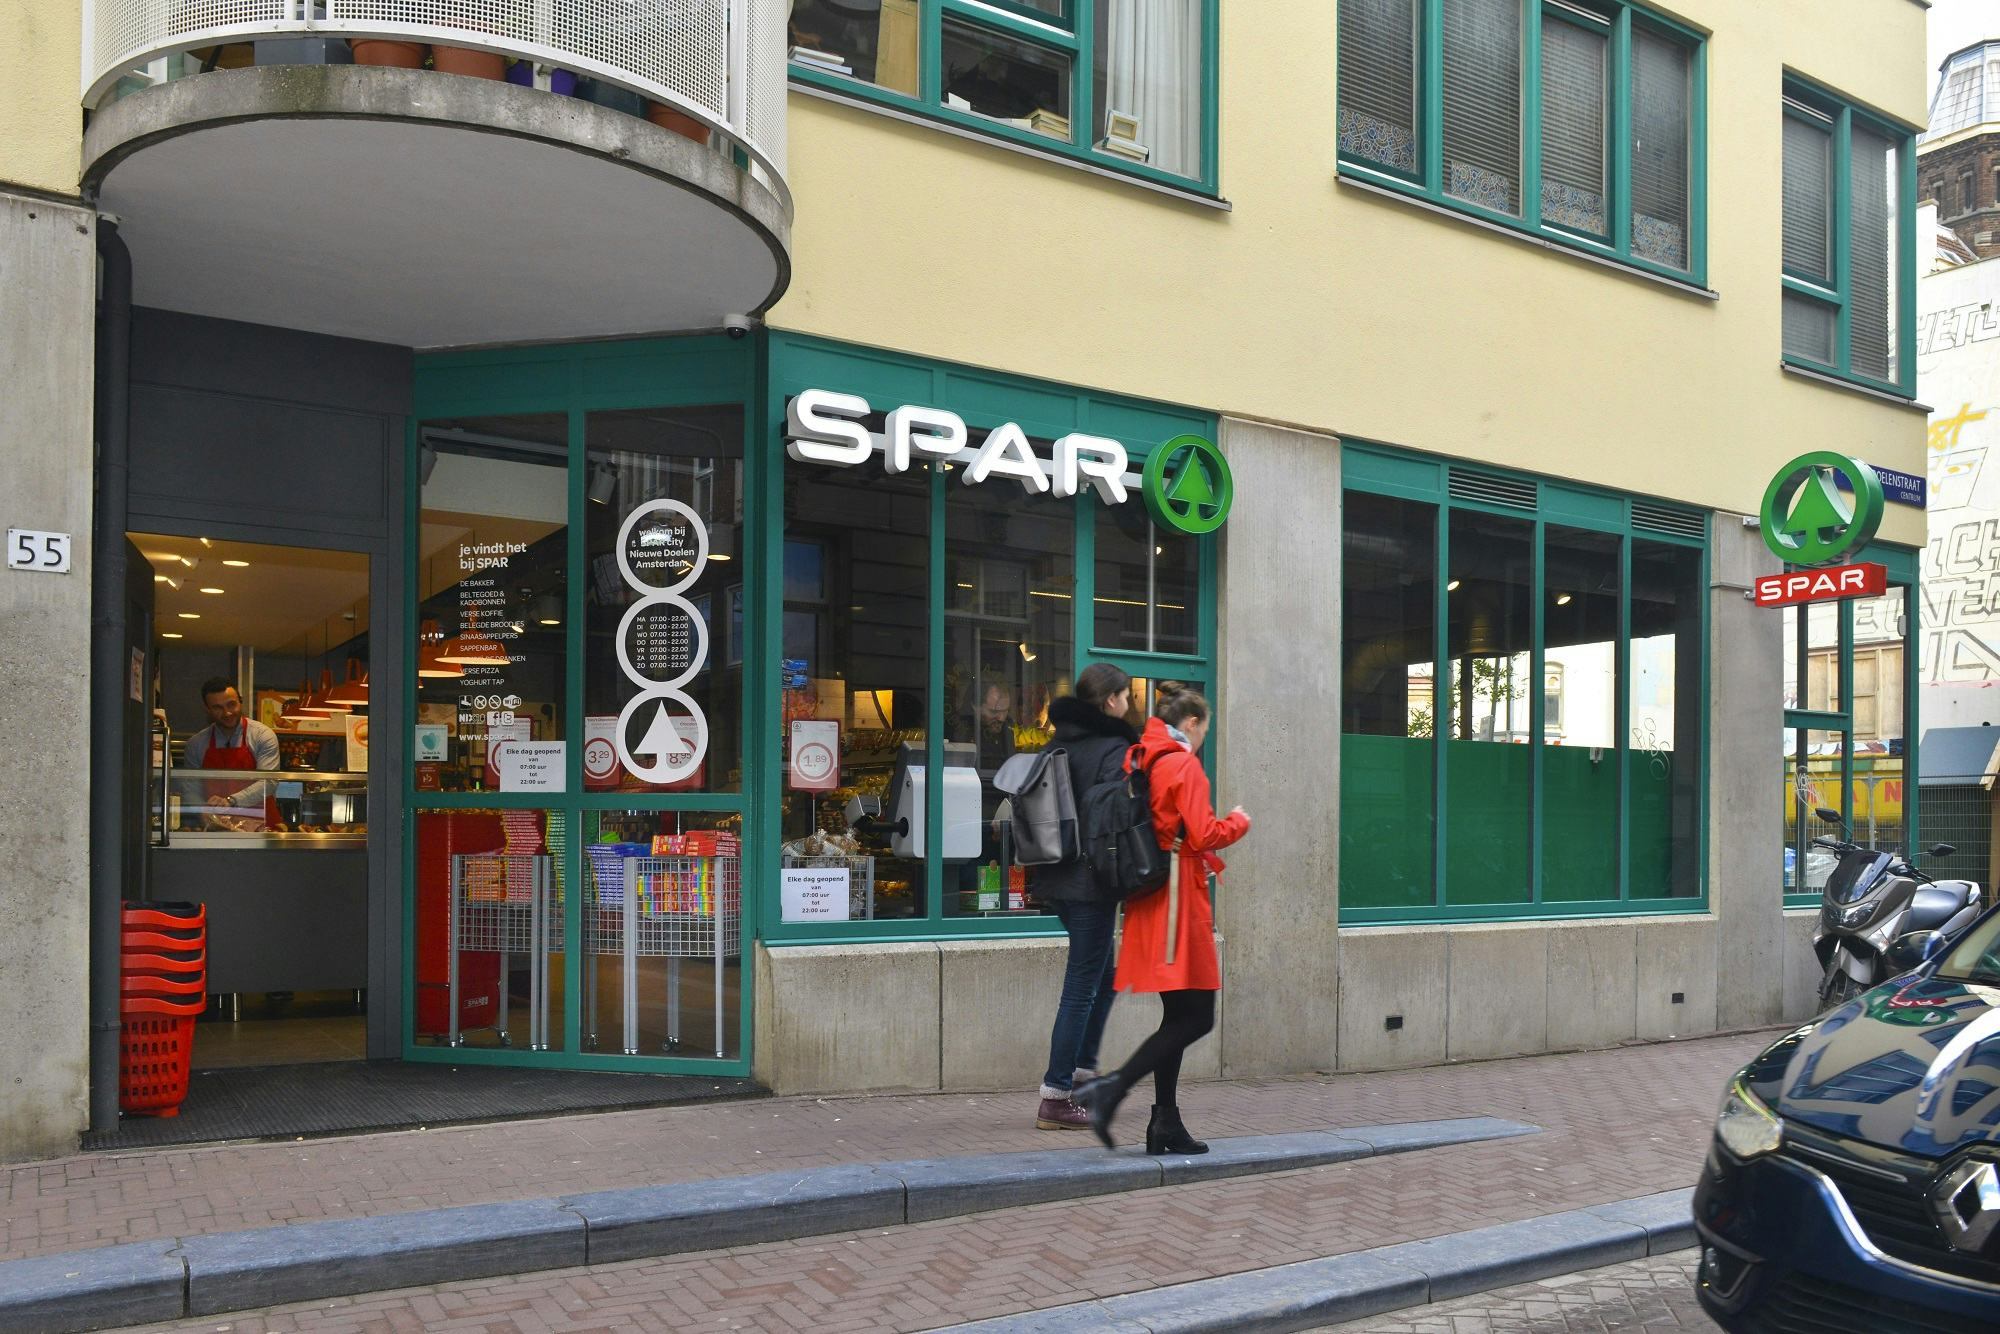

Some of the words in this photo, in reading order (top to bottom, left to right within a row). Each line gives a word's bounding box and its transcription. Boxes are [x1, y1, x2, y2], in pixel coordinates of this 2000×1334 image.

[786, 388, 1128, 505] SPAR
[1875, 469, 1921, 492] OELENSTRAAT
[1900, 491, 1921, 502] CENTRUM
[674, 526, 686, 536] bij
[666, 537, 684, 547] city
[16, 534, 63, 567] 55
[459, 544, 471, 557] je
[472, 542, 504, 554] vindt
[506, 541, 527, 553] het
[629, 549, 662, 558] Nieuwe
[663, 548, 695, 557] Doelen
[460, 558, 475, 571] bij
[476, 557, 509, 569] SPAR
[635, 559, 690, 569] Amsterdam
[469, 579, 495, 587] BAKKER
[1760, 569, 1864, 601] SPAR
[460, 591, 499, 599] BELTEGOED
[460, 598, 506, 606] KADOBONNEN
[480, 609, 504, 617] KOFFIE
[460, 644, 498, 652] SAPPENBAR
[521, 748, 533, 757] dag
[534, 748, 561, 757] geopend
[588, 750, 610, 764] 3.29
[803, 754, 827, 768] 1.89
